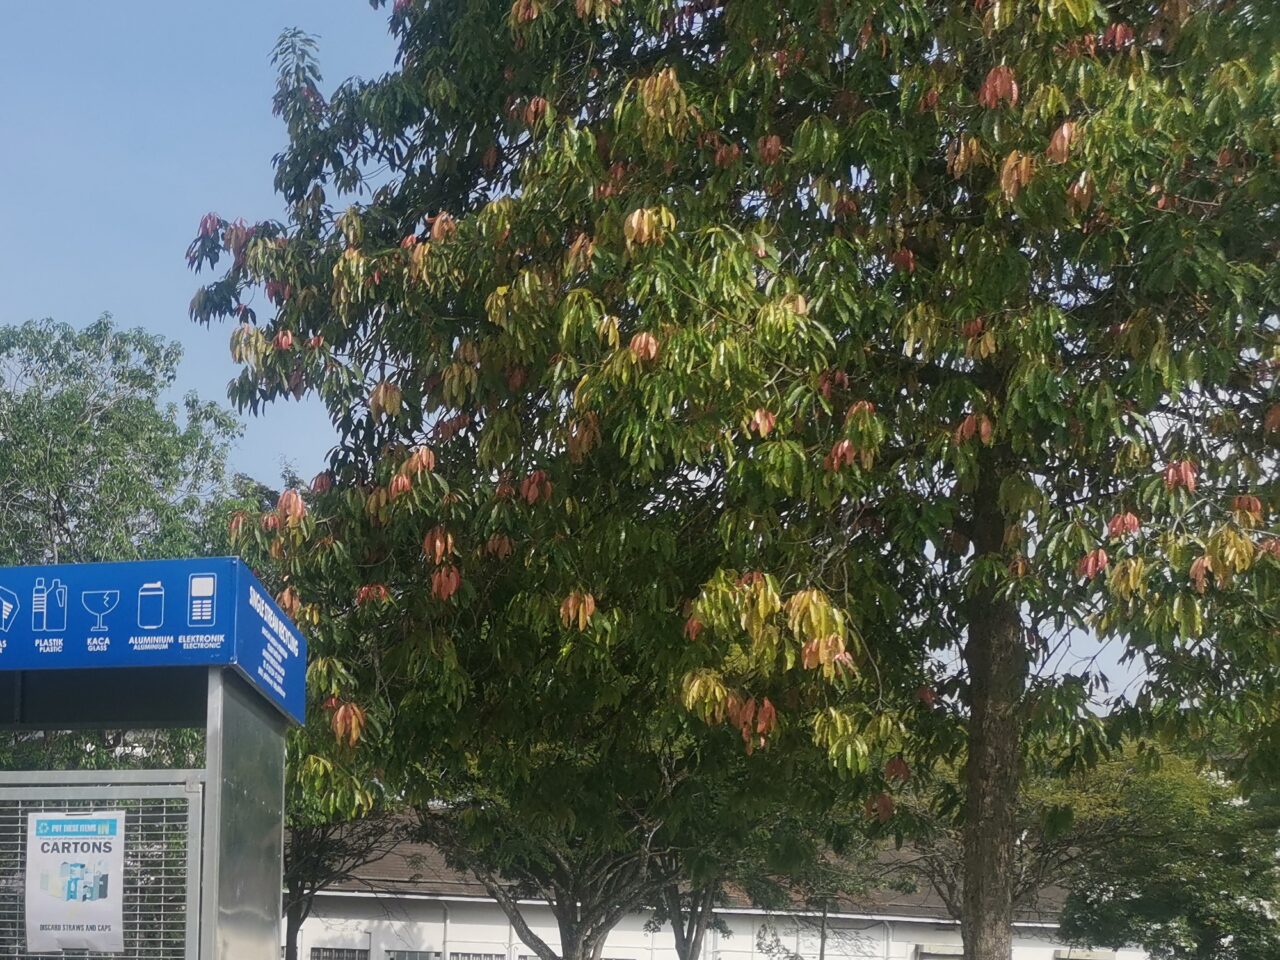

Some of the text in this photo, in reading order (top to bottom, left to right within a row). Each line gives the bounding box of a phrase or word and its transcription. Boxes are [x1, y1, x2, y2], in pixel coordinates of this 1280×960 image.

[35, 638, 63, 647] PLASTIK
[87, 637, 110, 645] KACA
[128, 635, 174, 644] ALUMINIUM
[178, 634, 225, 643] ELEKTRONIK
[41, 842, 112, 853] CARTONS
